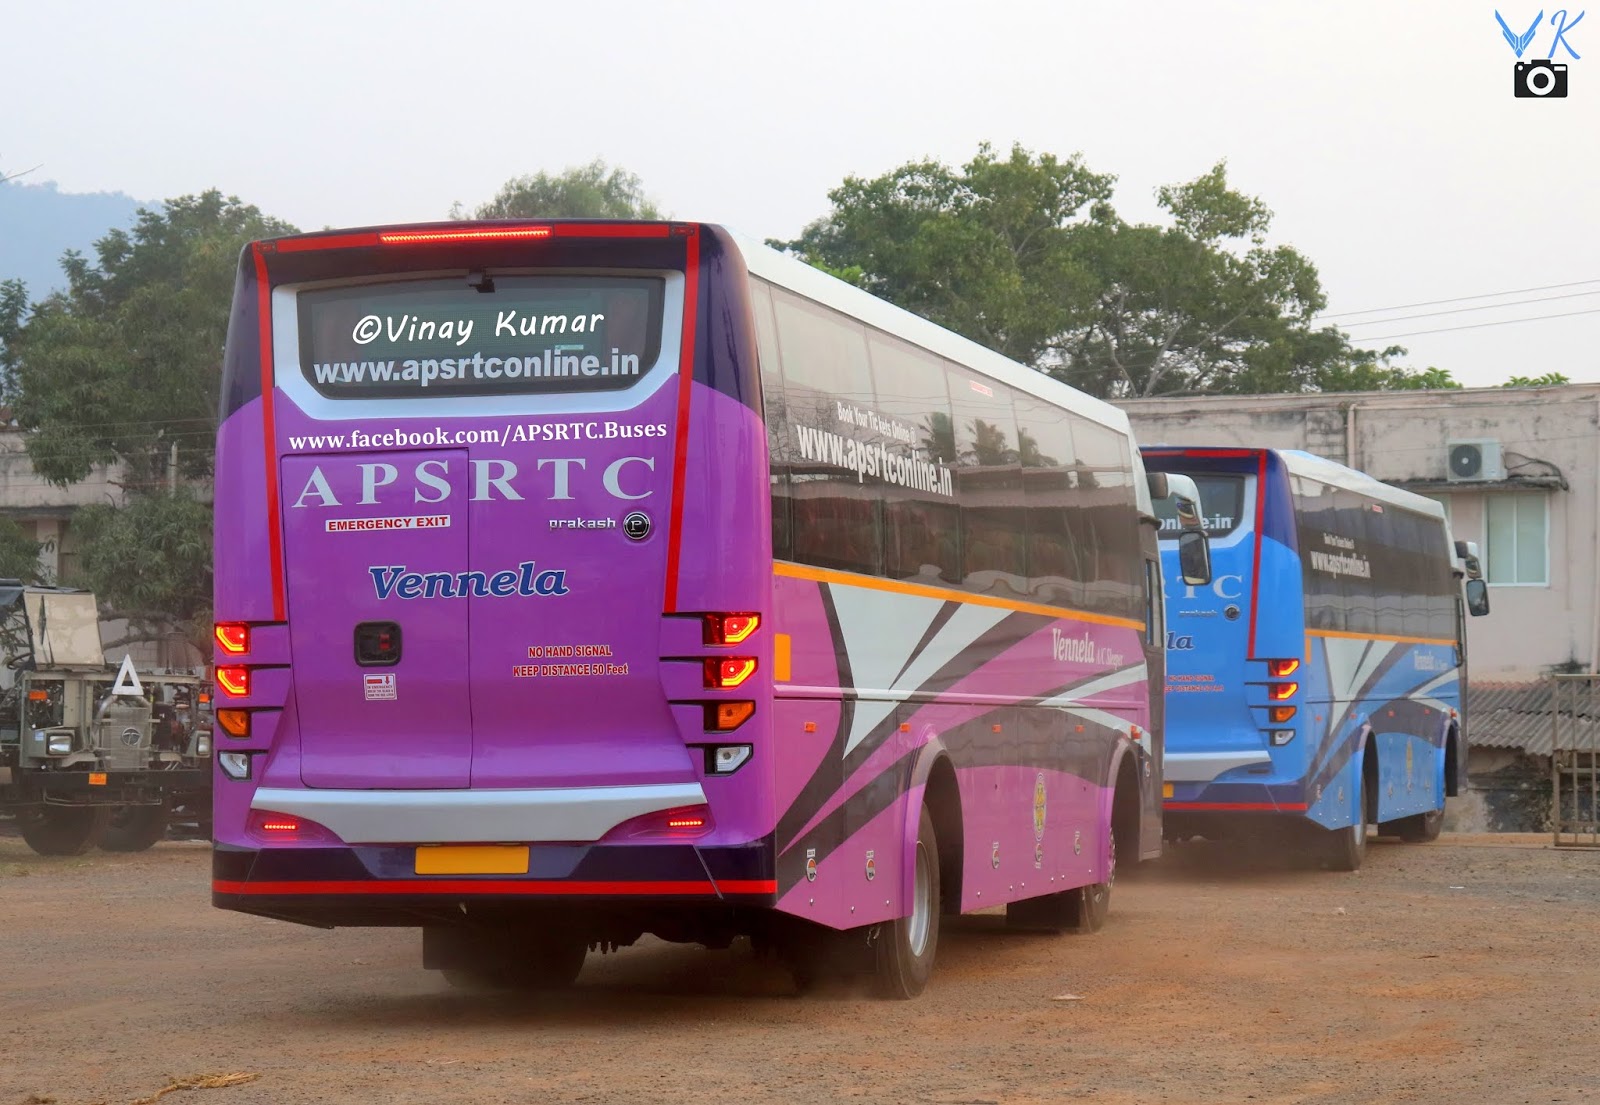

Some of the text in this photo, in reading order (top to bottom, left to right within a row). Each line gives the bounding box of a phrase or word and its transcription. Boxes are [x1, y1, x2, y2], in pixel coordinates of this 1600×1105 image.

[313, 348, 639, 387] www.apsrtconline.in
[288, 421, 667, 450] www.facebook.com/APSRTC.Buses
[797, 425, 953, 497] www.apsrtconline.in
[291, 456, 655, 508] APSRTC
[328, 516, 448, 531] EMERGENCY EXIT
[549, 517, 616, 531] prakash
[369, 561, 569, 599] Vennela
[528, 645, 613, 658] NO HAND SIGNAL
[1052, 628, 1095, 663] Vennela
[513, 662, 628, 677] KEEP DISTANCE 50 Feet
